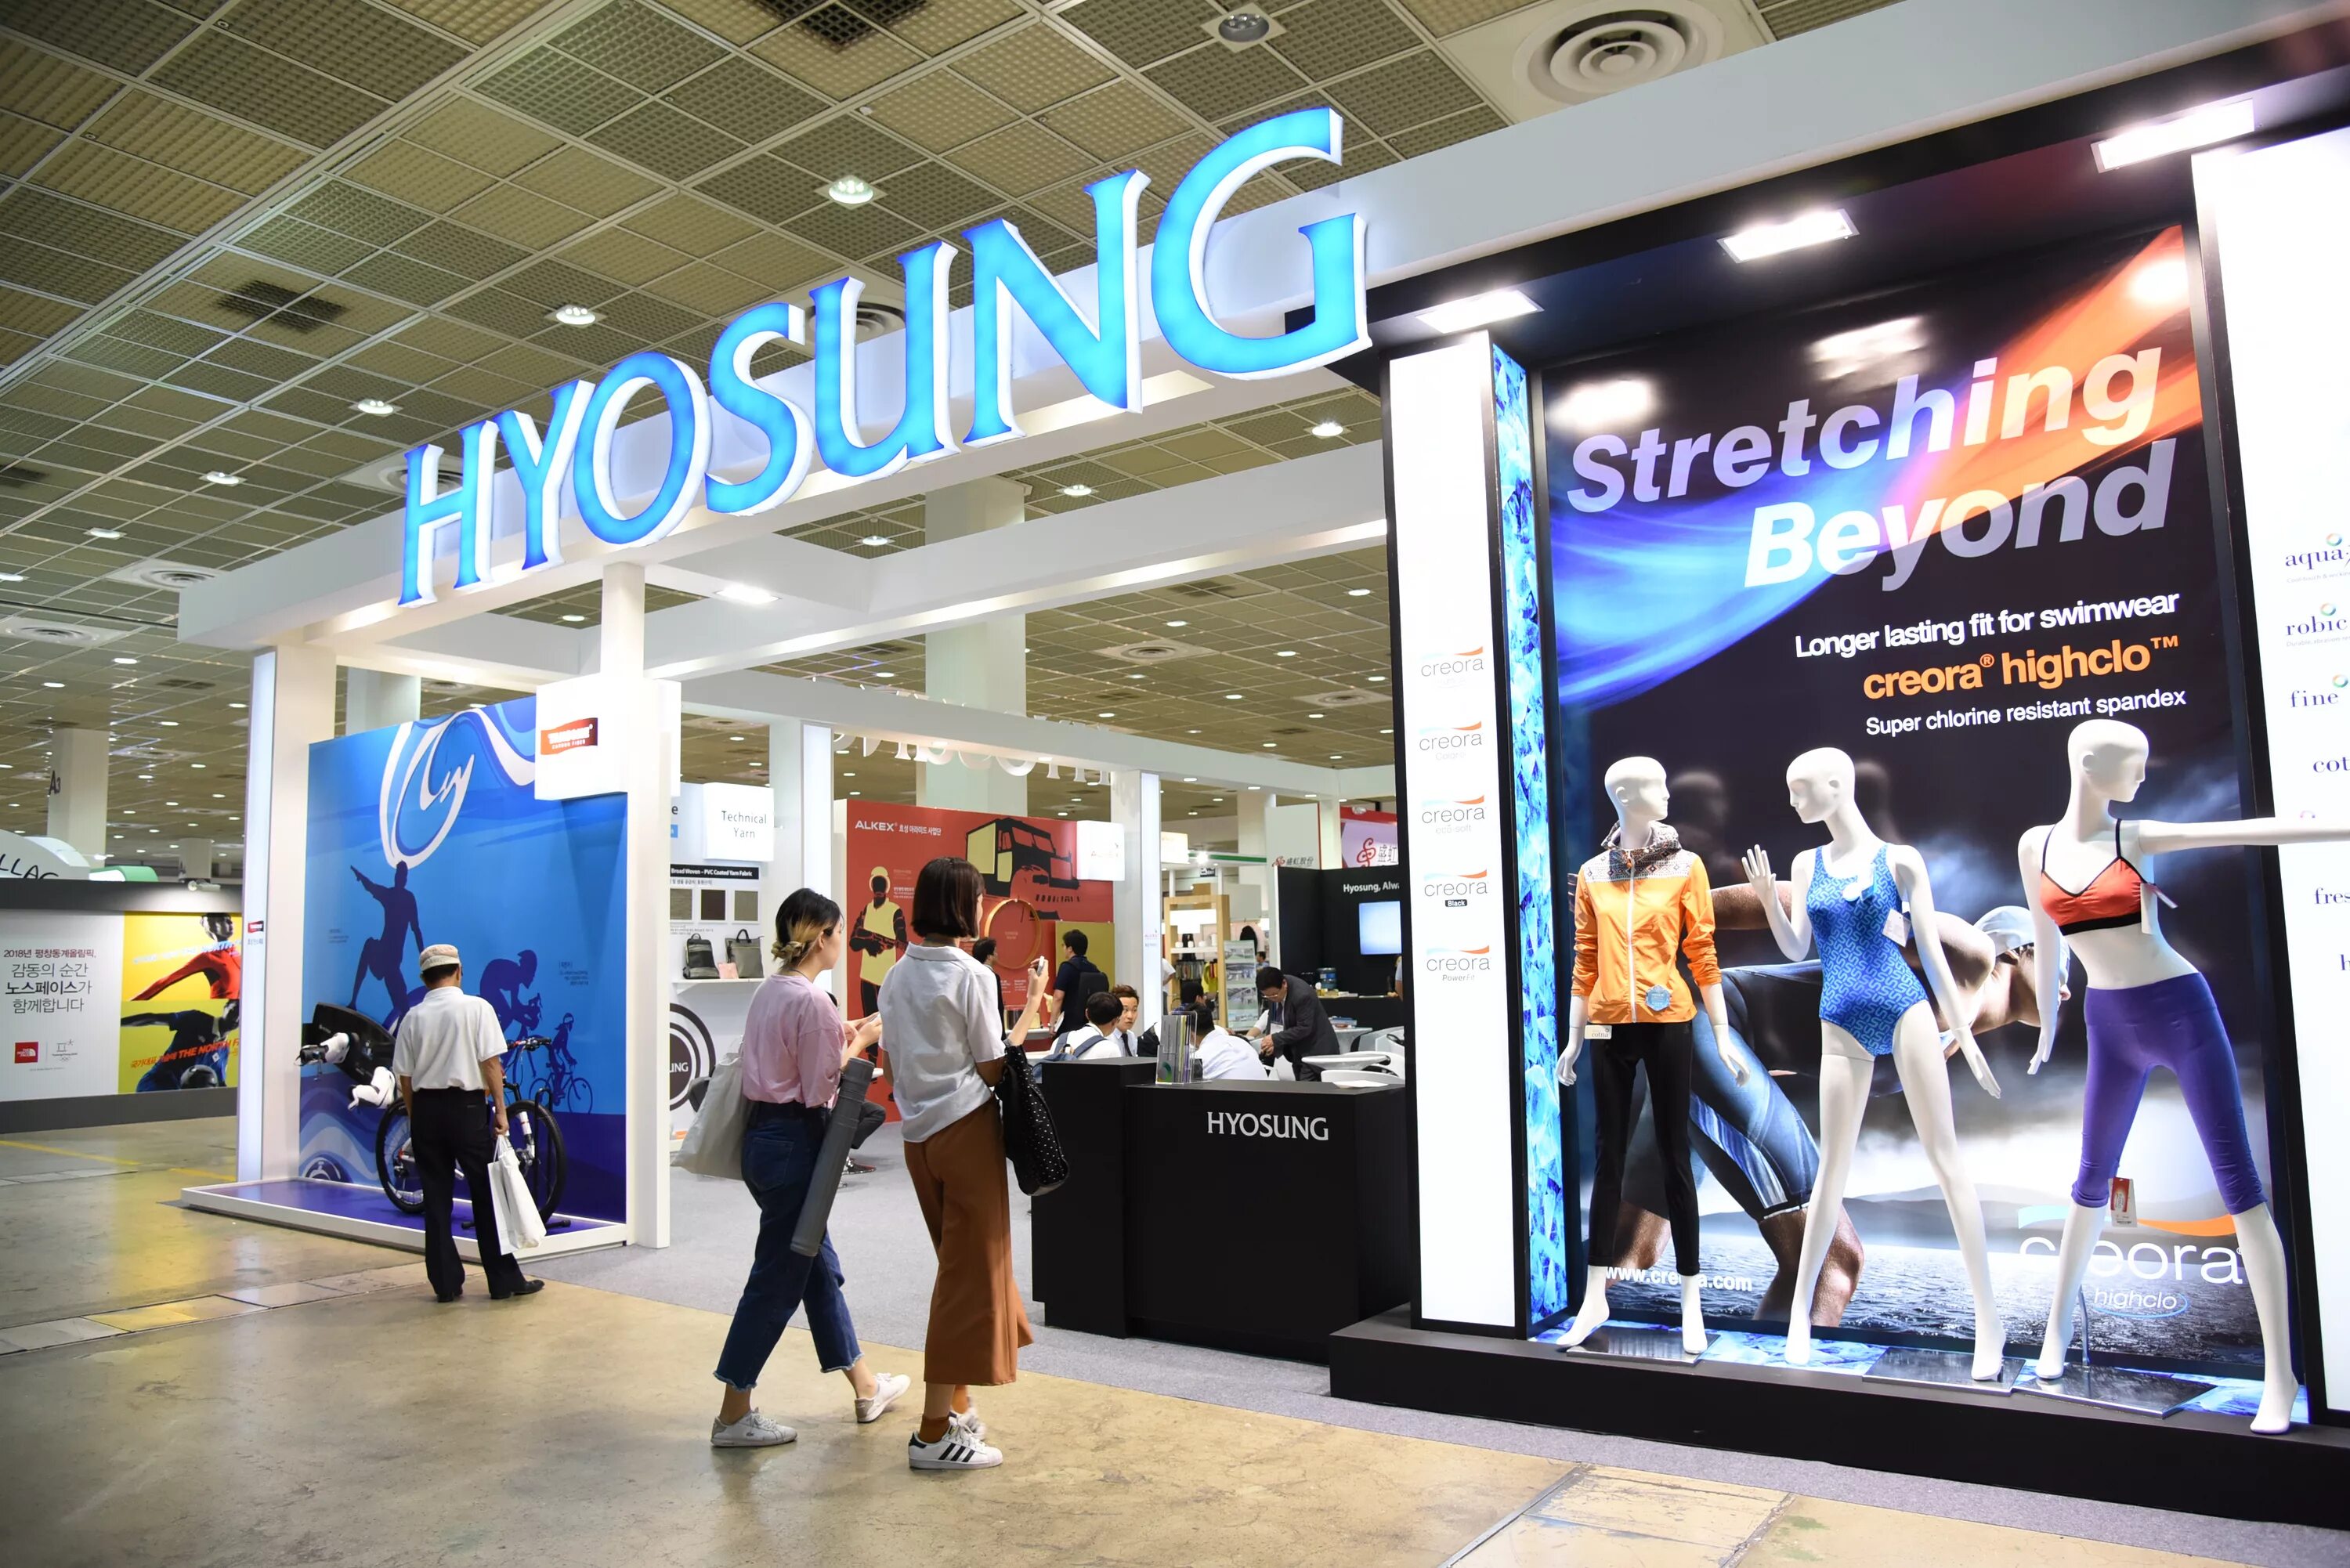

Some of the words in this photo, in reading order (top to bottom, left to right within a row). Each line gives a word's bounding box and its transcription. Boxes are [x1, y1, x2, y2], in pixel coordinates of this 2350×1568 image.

[398, 107, 1372, 606] HYOSUNG
[1567, 347, 2162, 513] Stretching
[1744, 439, 2178, 591] Beyond
[1795, 629, 1879, 658] Longer
[1885, 619, 1965, 646] lasting
[1969, 613, 1996, 637] fit
[1998, 609, 2035, 633] for
[2040, 592, 2180, 628] swimwear
[2285, 616, 2348, 636] robic
[1421, 658, 1484, 677] creora
[2291, 689, 2339, 708] fine
[1866, 715, 1922, 737] Super
[1925, 708, 2001, 730] chlorine
[2007, 697, 2091, 722] resistant
[2096, 689, 2186, 716] spandex
[1419, 733, 1482, 750] creora
[721, 810, 767, 825] Technical
[1422, 807, 1485, 823] creora
[733, 827, 756, 839] Yarn
[1343, 883, 1381, 894] Hyosung,
[1424, 882, 1488, 897] creora
[4, 949, 31, 958] 2018년
[12, 963, 55, 977] 감동의
[60, 963, 89, 977] 순간
[1426, 958, 1491, 971] creora
[5, 980, 92, 995] 노스페이스가
[13, 998, 85, 1013] 함께합니다
[179, 1046, 197, 1059] THE
[1207, 1111, 1329, 1141] HYOSUNG
[1606, 1266, 1752, 1292] www.crea.com
[2094, 1288, 2178, 1310] highclo
